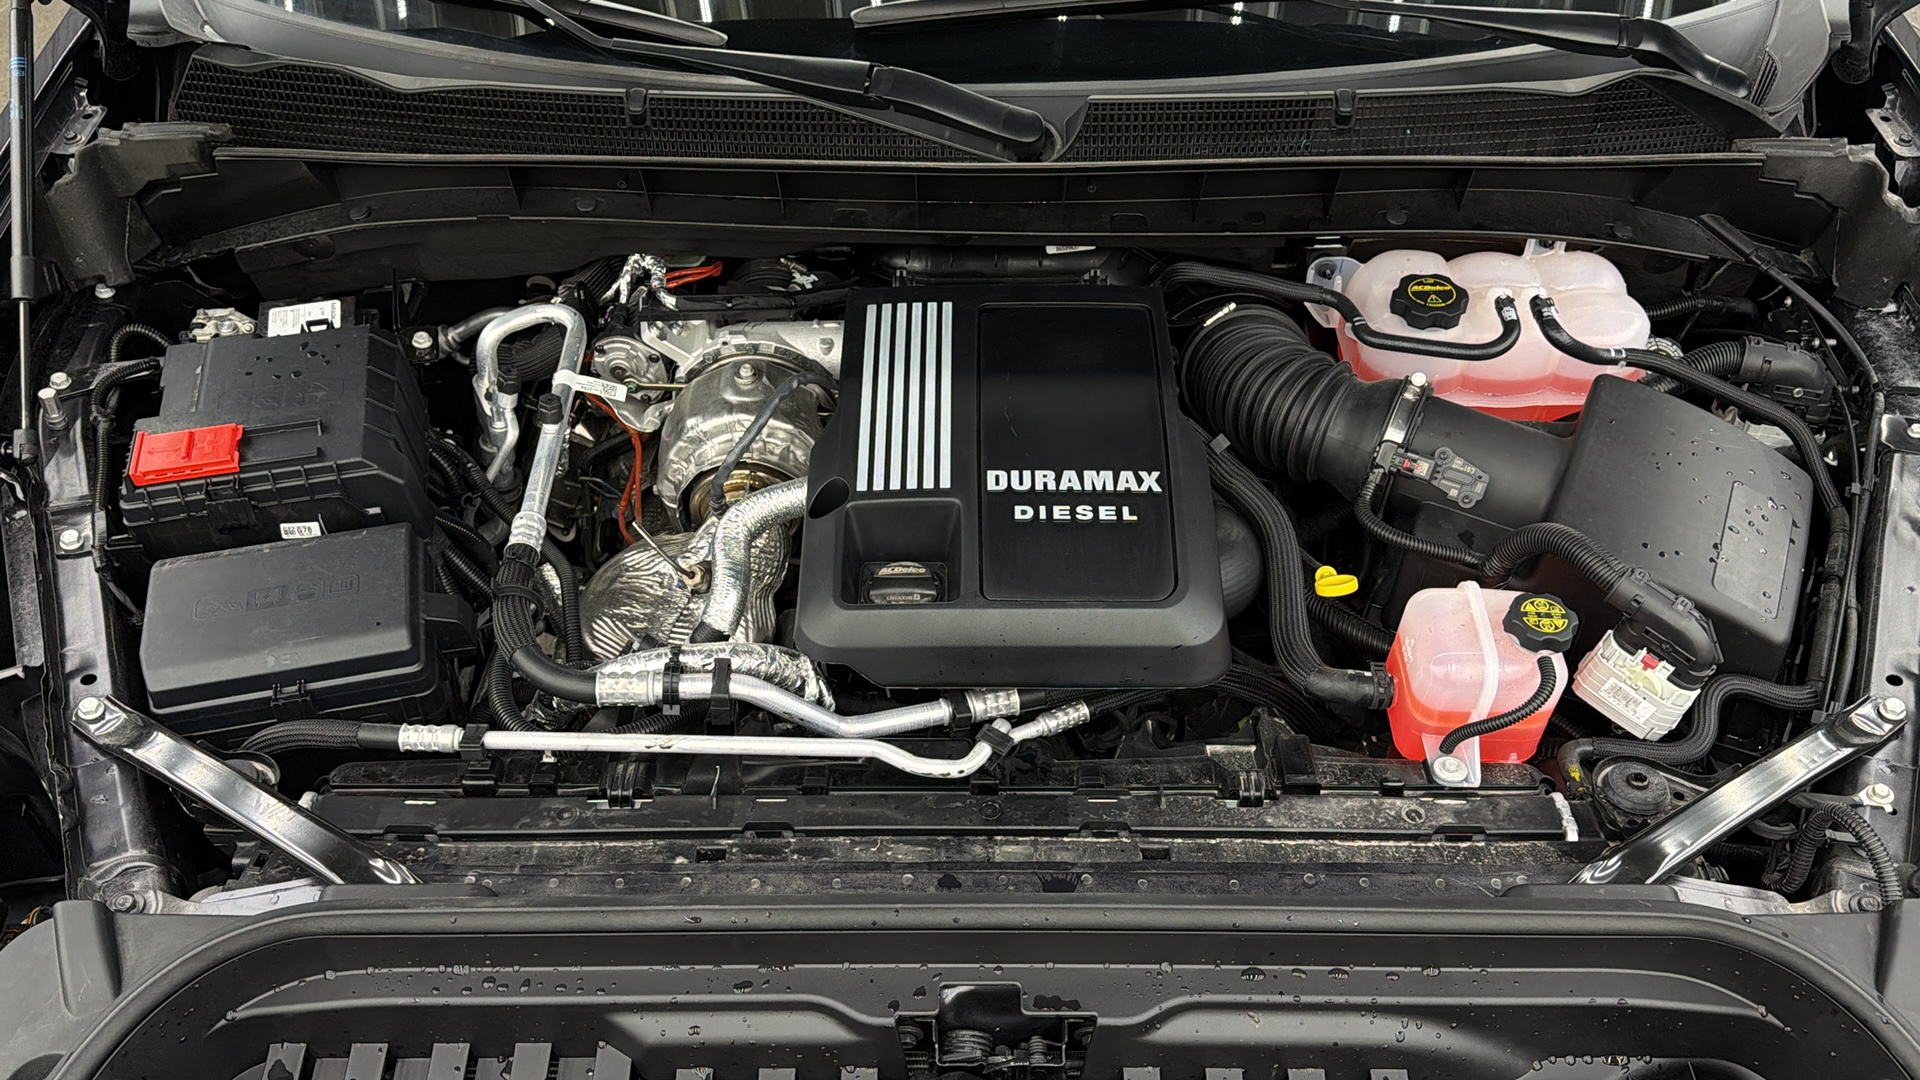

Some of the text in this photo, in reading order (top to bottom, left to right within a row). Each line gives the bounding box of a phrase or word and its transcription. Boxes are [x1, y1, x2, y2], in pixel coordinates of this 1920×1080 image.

[1410, 285, 1453, 293] ACDelco
[986, 470, 1162, 493] DURAMAX
[1014, 505, 1138, 522] DIESEL
[878, 566, 927, 576] ACDelco
